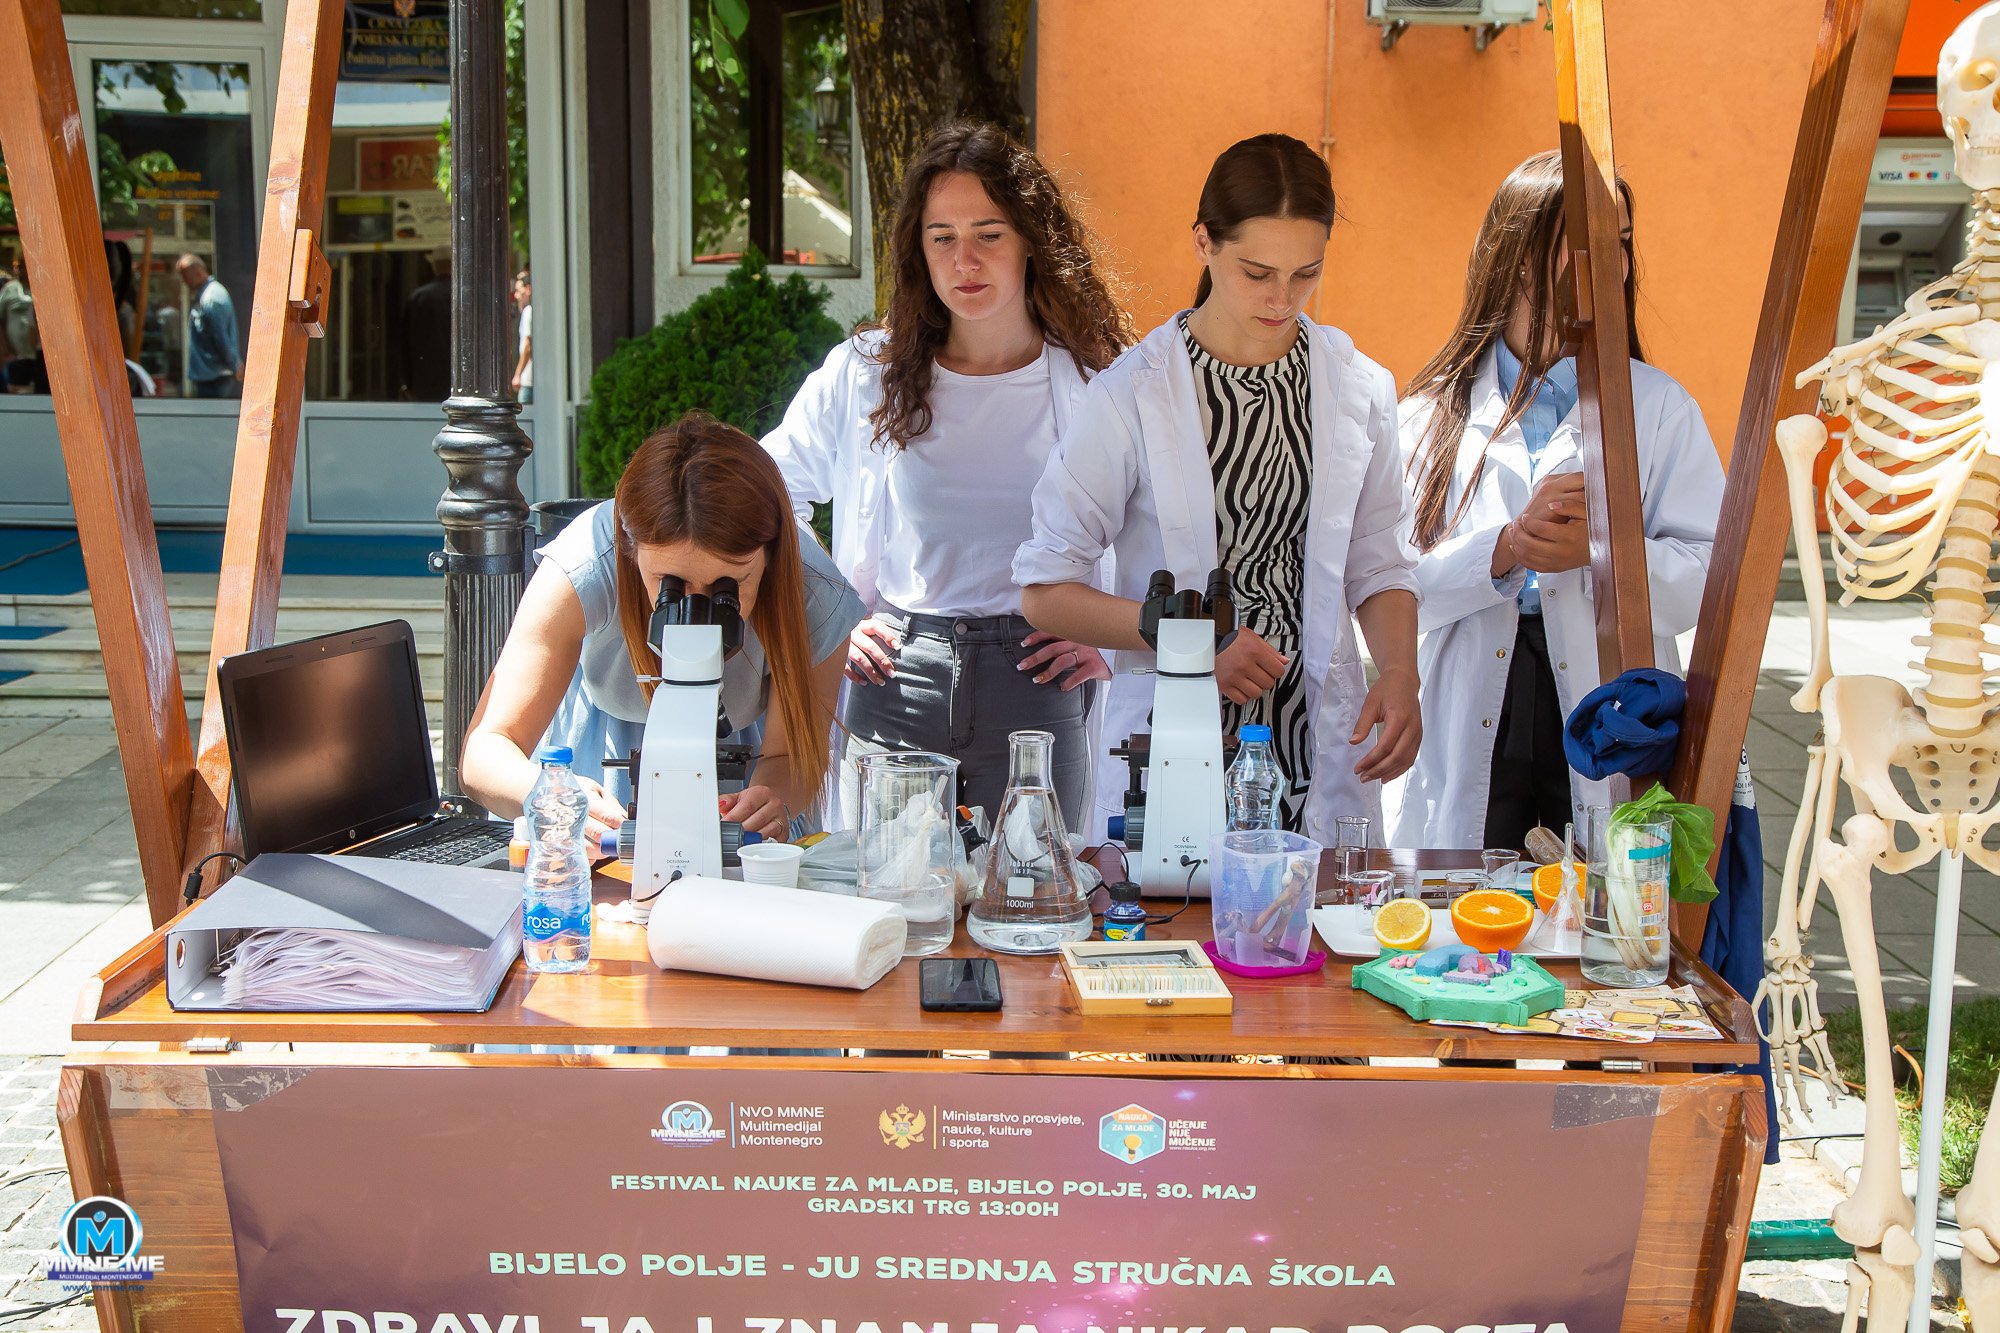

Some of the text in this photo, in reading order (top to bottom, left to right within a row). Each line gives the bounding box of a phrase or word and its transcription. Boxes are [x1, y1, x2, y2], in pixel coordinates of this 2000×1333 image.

[1880, 172, 1903, 180] VISA
[1006, 900, 1034, 908] 1000ml
[526, 916, 563, 929] rosa
[739, 1106, 825, 1118] NVO MMNE
[942, 1109, 1085, 1127] Ministarstvo prosvjete,
[1117, 1113, 1148, 1121] NAUKA
[740, 1120, 822, 1134] Multimedijal
[1112, 1124, 1155, 1132] ZA MLADE
[1168, 1119, 1208, 1130] UČENJE
[942, 1125, 1033, 1137] nauke, kulture
[1168, 1129, 1191, 1137] NIJE
[740, 1135, 823, 1149] Montenegro
[942, 1137, 990, 1149] i sporta
[1168, 1137, 1216, 1147] MUČENJE
[610, 1175, 1257, 1201] FESTIVAL NAUKE ZA MLADE, BIJELO POLJE, 30. MAJ
[807, 1197, 1060, 1217] GRADSKI TRG 13:00H
[489, 1252, 1396, 1287] BIJELO POLJE - JU SREDNJA STRUČNA ŠKOLA
